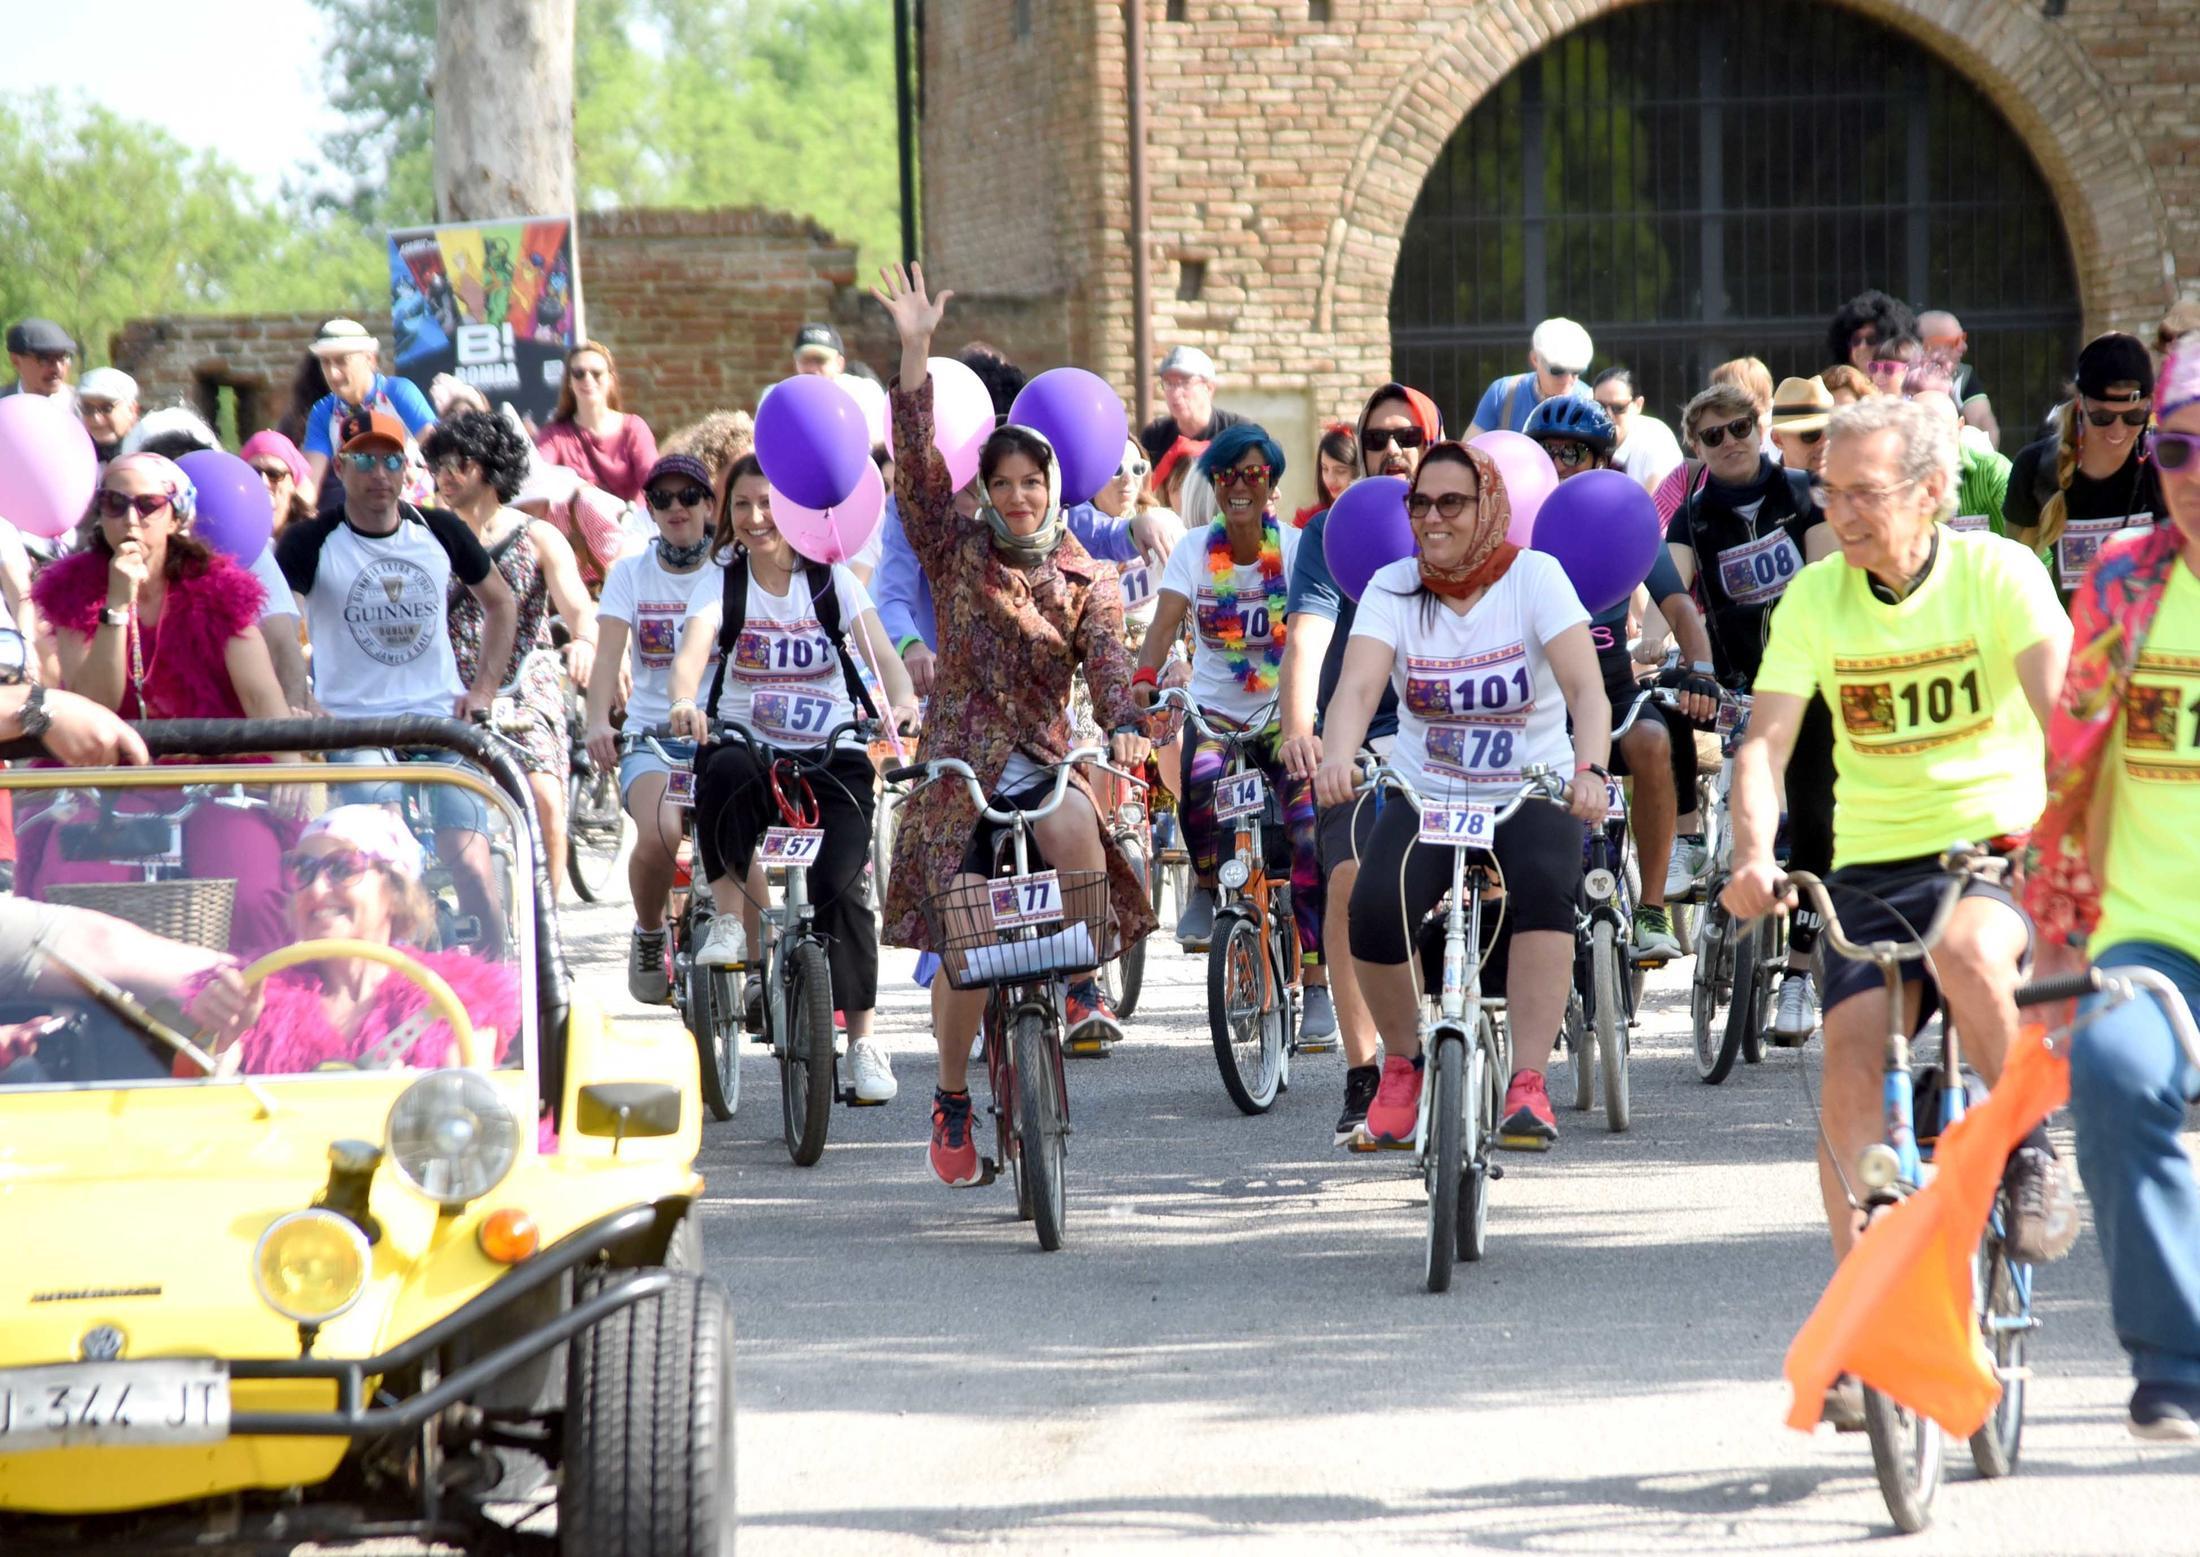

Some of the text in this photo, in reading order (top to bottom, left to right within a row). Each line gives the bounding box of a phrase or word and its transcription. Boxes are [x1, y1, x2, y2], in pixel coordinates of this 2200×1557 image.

[457, 322, 516, 365] B!
[1755, 543, 1794, 585] 08
[1122, 570, 1149, 601] 11
[344, 601, 439, 623] GUINNESS
[774, 637, 829, 668] 101
[1455, 666, 1529, 711] 101
[1900, 668, 1980, 727] 101
[791, 697, 832, 732] 57
[1469, 729, 1514, 769] 78
[1237, 779, 1256, 804] 14
[1455, 812, 1484, 835] 78
[787, 837, 815, 857] 57
[1024, 882, 1050, 911] 77
[47, 1384, 131, 1428] 344
[166, 1383, 217, 1428] JT
